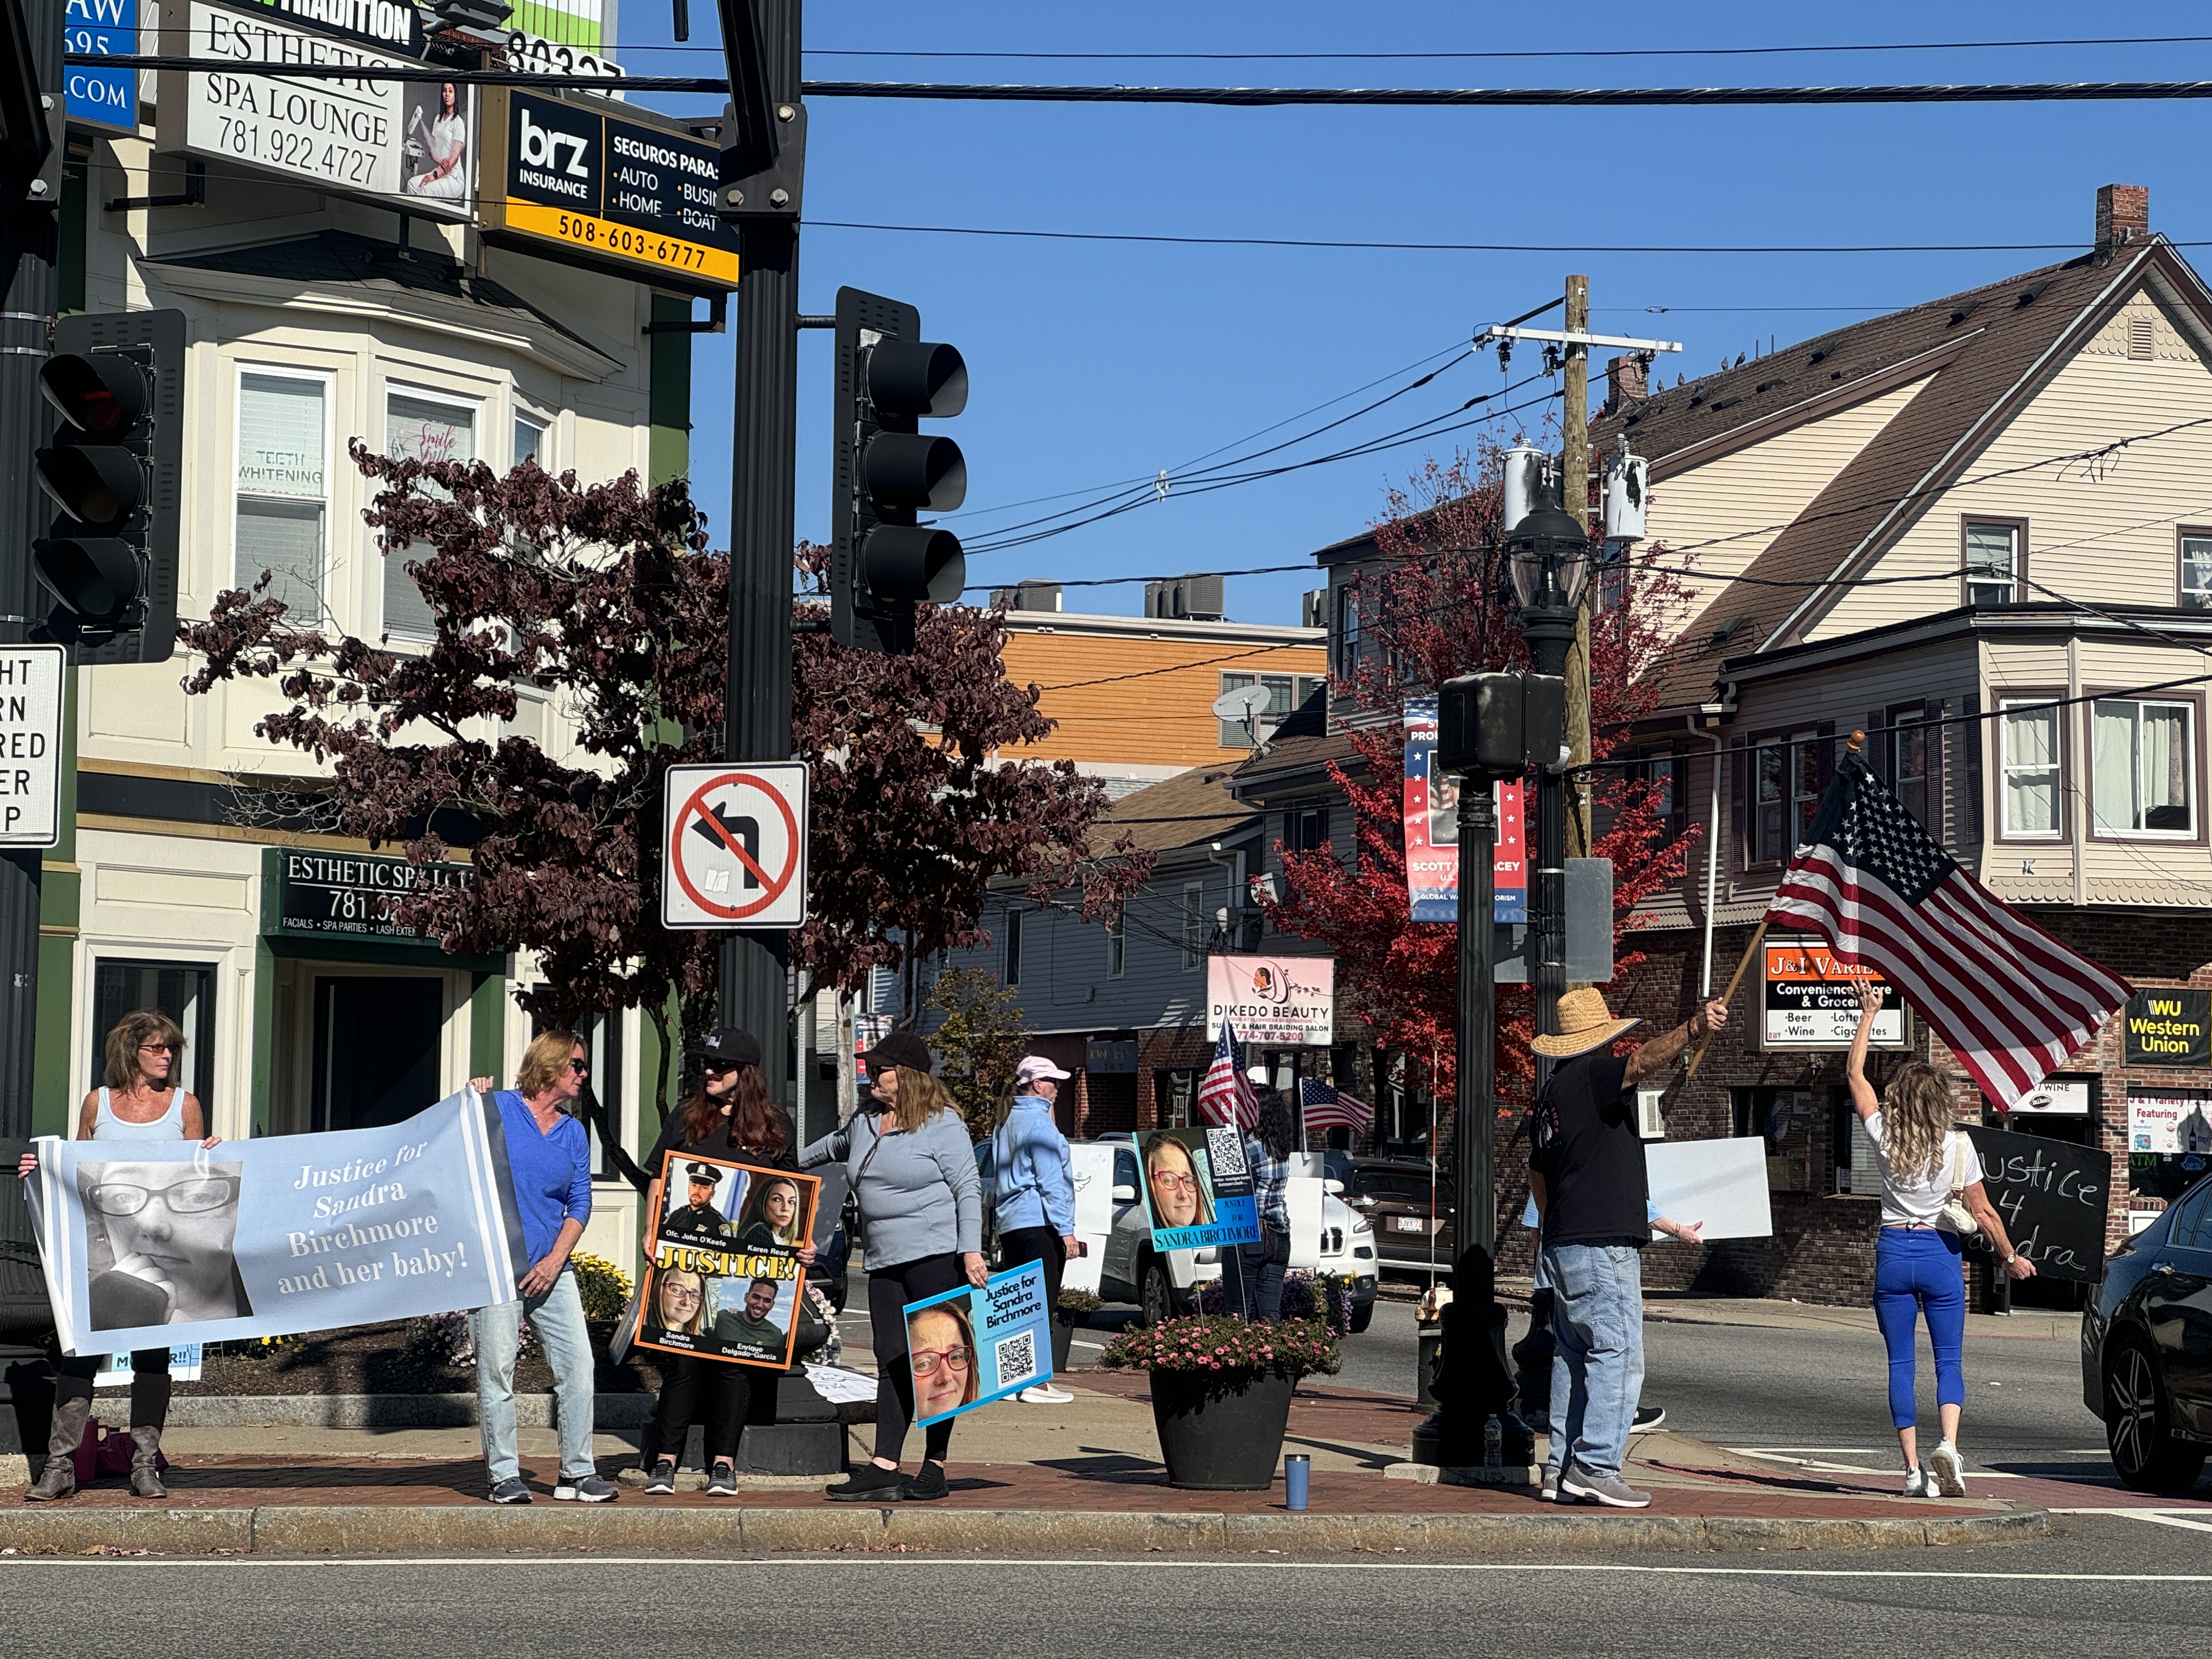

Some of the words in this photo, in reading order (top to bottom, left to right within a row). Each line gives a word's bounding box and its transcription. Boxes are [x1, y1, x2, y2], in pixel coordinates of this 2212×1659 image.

[280, 0, 411, 46] ADITION
[206, 13, 389, 98] ESTHETIC
[206, 73, 259, 115] SPA
[267, 88, 389, 147] LOUNGE
[219, 115, 377, 185] 781.922.4727
[520, 109, 589, 178] brz
[614, 136, 677, 168] SEGUROS
[680, 154, 719, 180] PARA:
[520, 168, 588, 199] INSURANCE
[619, 166, 658, 190] AUTO
[619, 191, 662, 217] HOME
[683, 208, 719, 232] BOAT
[558, 215, 706, 269] 508-603-6777
[418, 422, 457, 449] Smile
[256, 450, 304, 466] TEETH
[238, 466, 323, 484] WHITENING
[287, 855, 389, 886] ESTHETIC
[1412, 861, 1453, 872] SCOTT
[283, 917, 313, 929] FACIALS
[323, 920, 337, 931] SPA
[338, 922, 368, 933] PARTIES
[376, 925, 394, 935] LASH
[1814, 957, 1876, 975] VARIE
[1802, 996, 1811, 1007] &
[2148, 1000, 2182, 1016] WU
[1214, 1005, 1268, 1017] DIKEDO
[1273, 1006, 1329, 1019] BEAUTY
[1787, 1012, 1813, 1022] Beer
[1237, 1030, 1304, 1041] 774-707-5200
[1788, 1026, 1815, 1036] Wine
[1833, 1026, 1887, 1038] Cigates
[2129, 1018, 2200, 1036] Western
[2141, 1036, 2189, 1053] Union
[2154, 1095, 2185, 1107] Variety
[2136, 1108, 2177, 1121] Featuring
[294, 1158, 387, 1189] Justice
[392, 1141, 428, 1167] for
[313, 1182, 407, 1219] Sandra
[1999, 1189, 2025, 1227] 4
[1232, 1214, 1244, 1223] FOR
[286, 1215, 438, 1258] Birchmore
[681, 1233, 698, 1242] John
[700, 1236, 727, 1247] O'Keefe
[1155, 1231, 1200, 1249] SANDRA
[1200, 1225, 1257, 1244] BIRCHMORE
[747, 1244, 769, 1254] Karen
[770, 1248, 789, 1257] Read
[278, 1265, 330, 1294] and
[334, 1261, 383, 1285] her
[390, 1242, 467, 1278] baby!
[657, 1246, 796, 1280] JUSTICE!
[985, 1283, 1020, 1302] Justice
[1021, 1276, 1037, 1289] for
[993, 1291, 1033, 1313] Sandra
[986, 1302, 1041, 1329] Birchmore
[659, 1338, 695, 1350] Birchmore
[665, 1331, 690, 1342] Sandra
[721, 1347, 777, 1361] Delgado-Garcia
[737, 1343, 764, 1353] Enrique
